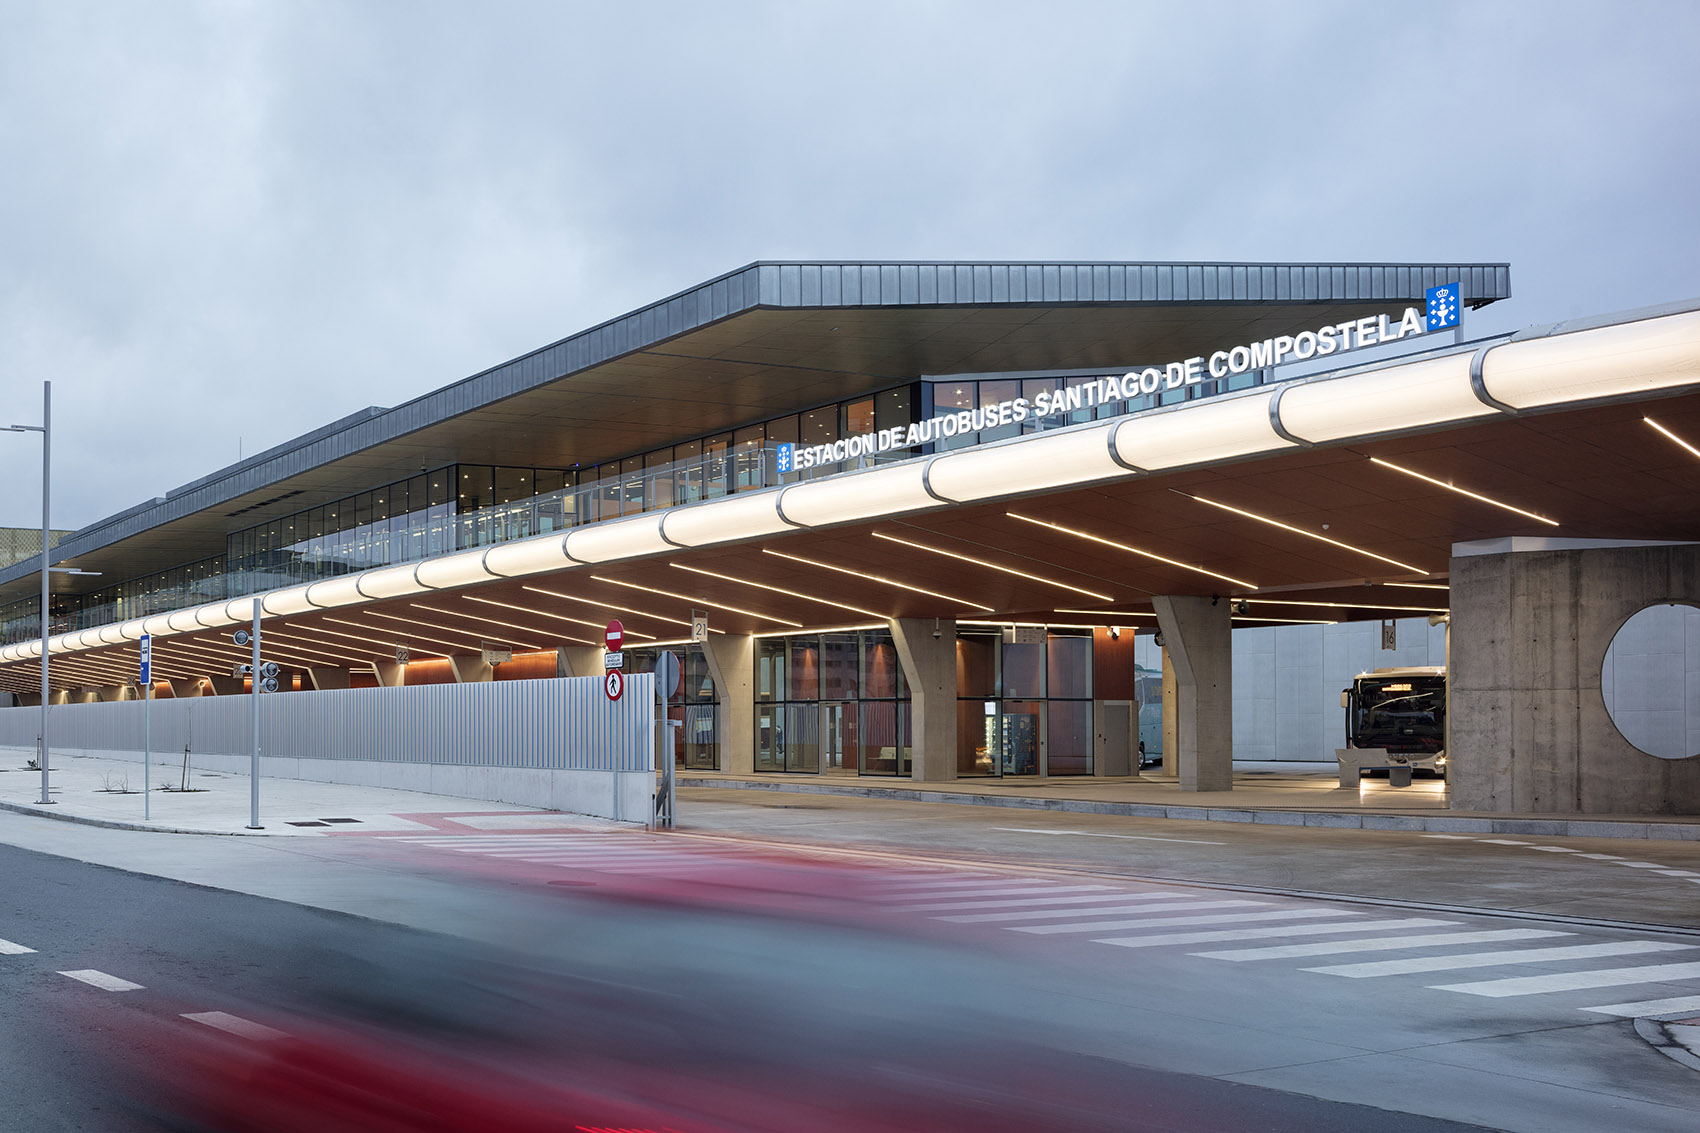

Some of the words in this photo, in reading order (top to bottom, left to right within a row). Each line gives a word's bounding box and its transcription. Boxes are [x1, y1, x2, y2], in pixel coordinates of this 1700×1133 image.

[793, 432, 877, 471] ESTACION
[878, 425, 905, 452] DE
[905, 397, 1031, 446] AUTOBUSES
[1034, 367, 1163, 417] SANTIAGO
[1166, 356, 1205, 389] DE
[1208, 307, 1426, 378] COMPOSTELA
[695, 622, 707, 637] 21
[1385, 630, 1394, 645] 16
[397, 651, 409, 662] 22
